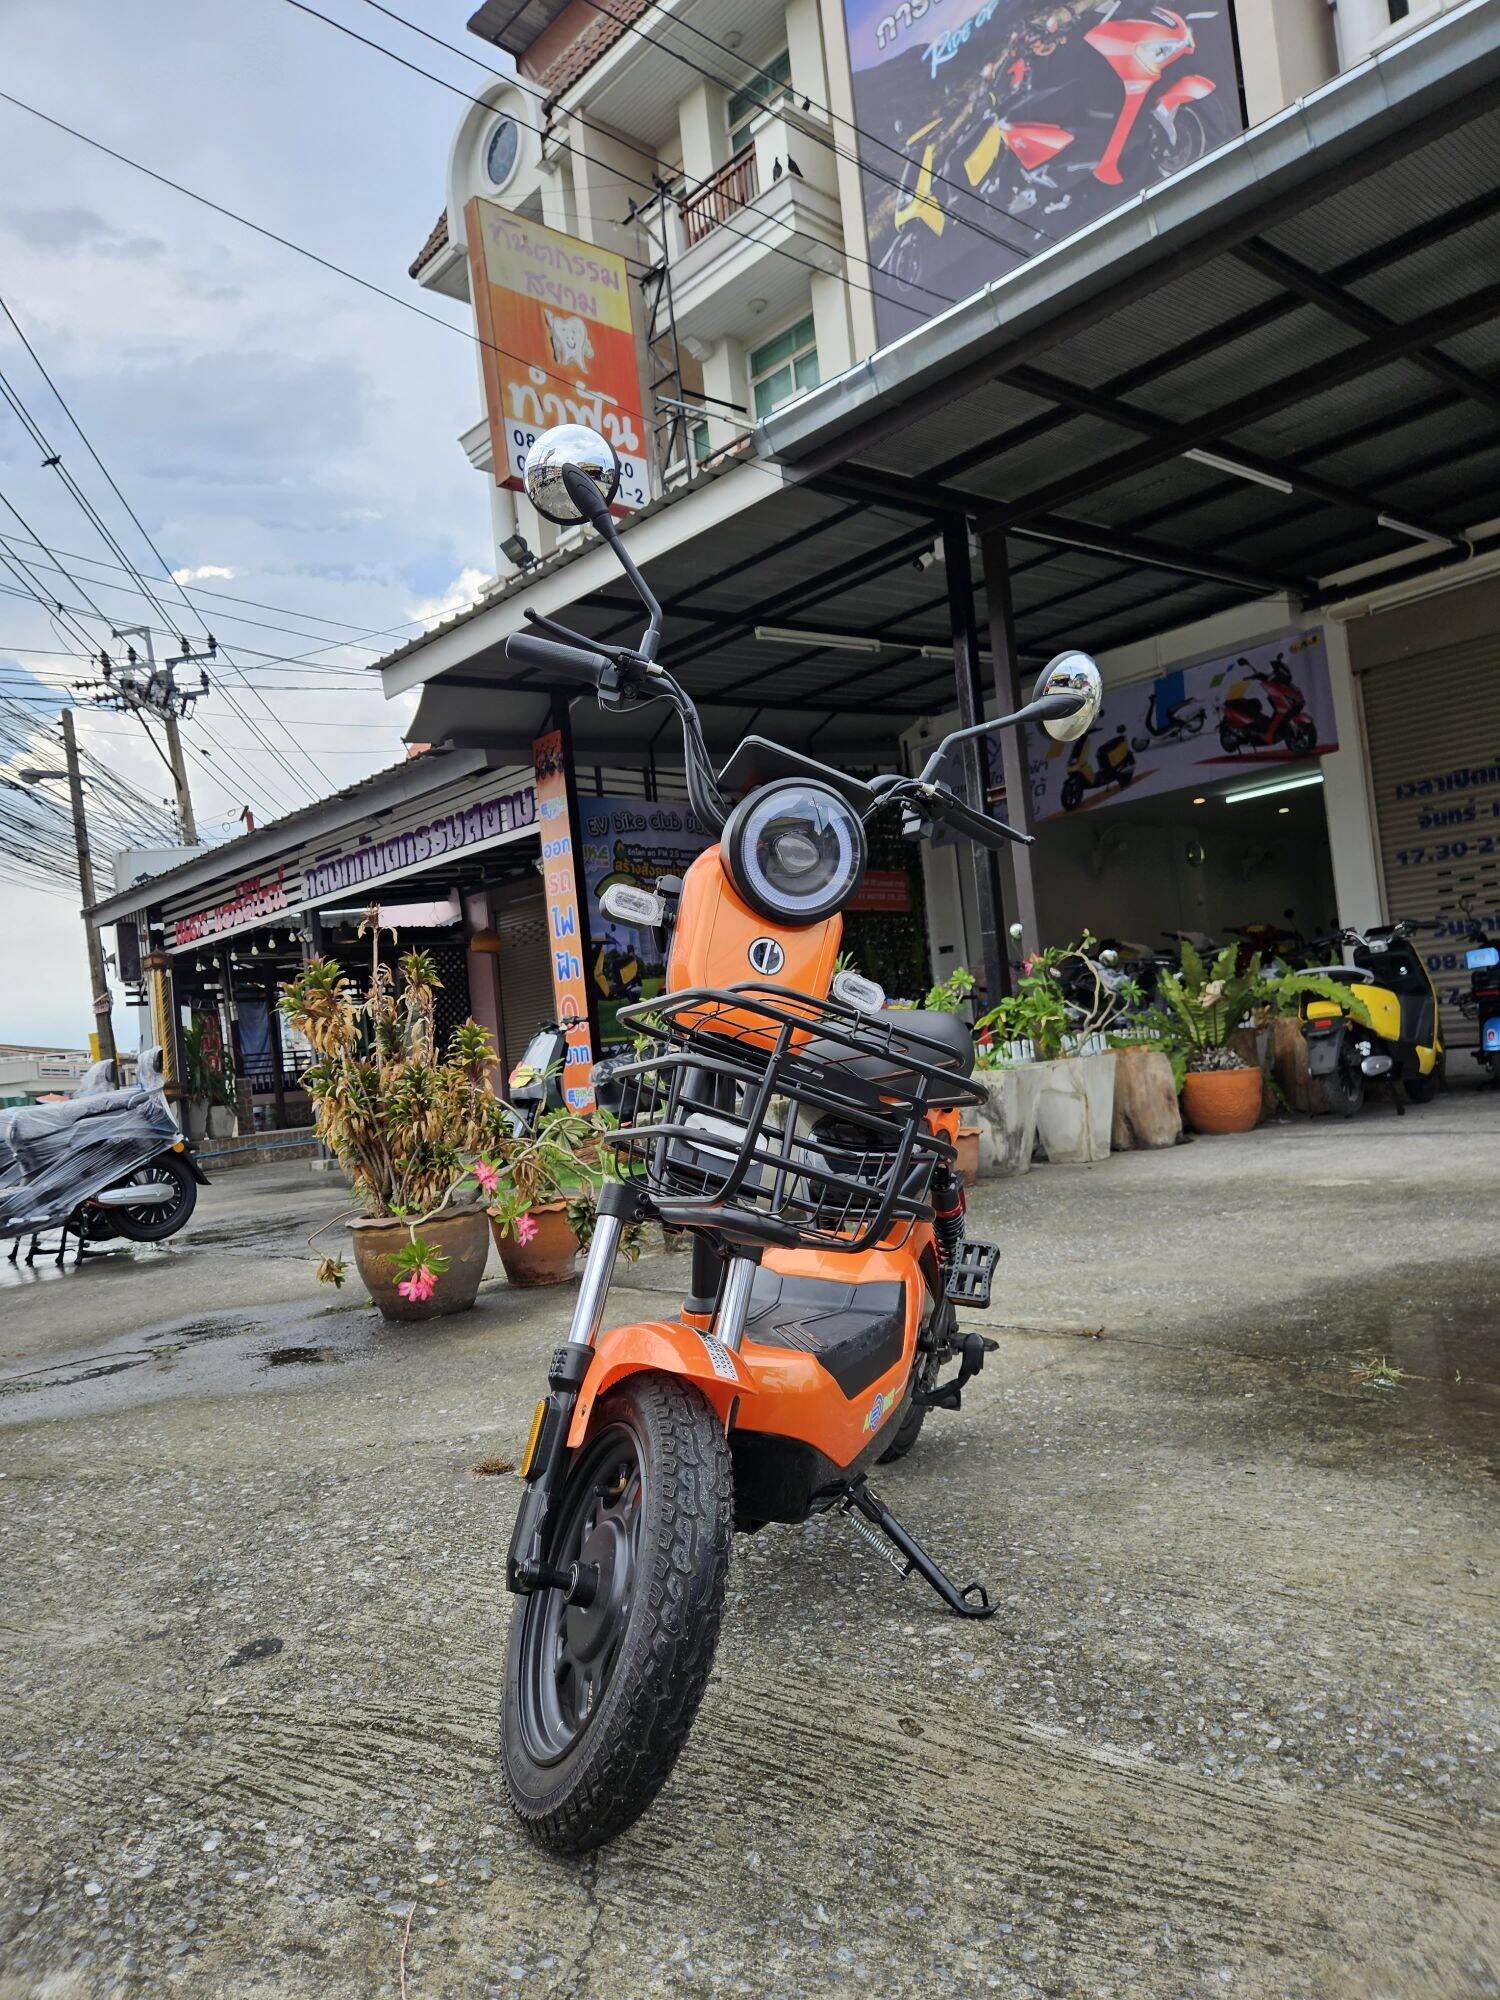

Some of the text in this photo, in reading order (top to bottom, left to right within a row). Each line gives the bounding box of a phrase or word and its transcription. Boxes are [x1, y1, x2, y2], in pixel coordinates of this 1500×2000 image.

[524, 270, 598, 316] สยาม
[508, 365, 639, 451] ทำฟัน
[586, 815, 608, 837] EV
[613, 810, 646, 833] bike
[648, 810, 682, 831] club
[301, 786, 536, 900] คลินิกทันตกรรมสยาม
[544, 838, 571, 859] ออก
[1397, 838, 1500, 866] 17.30-2
